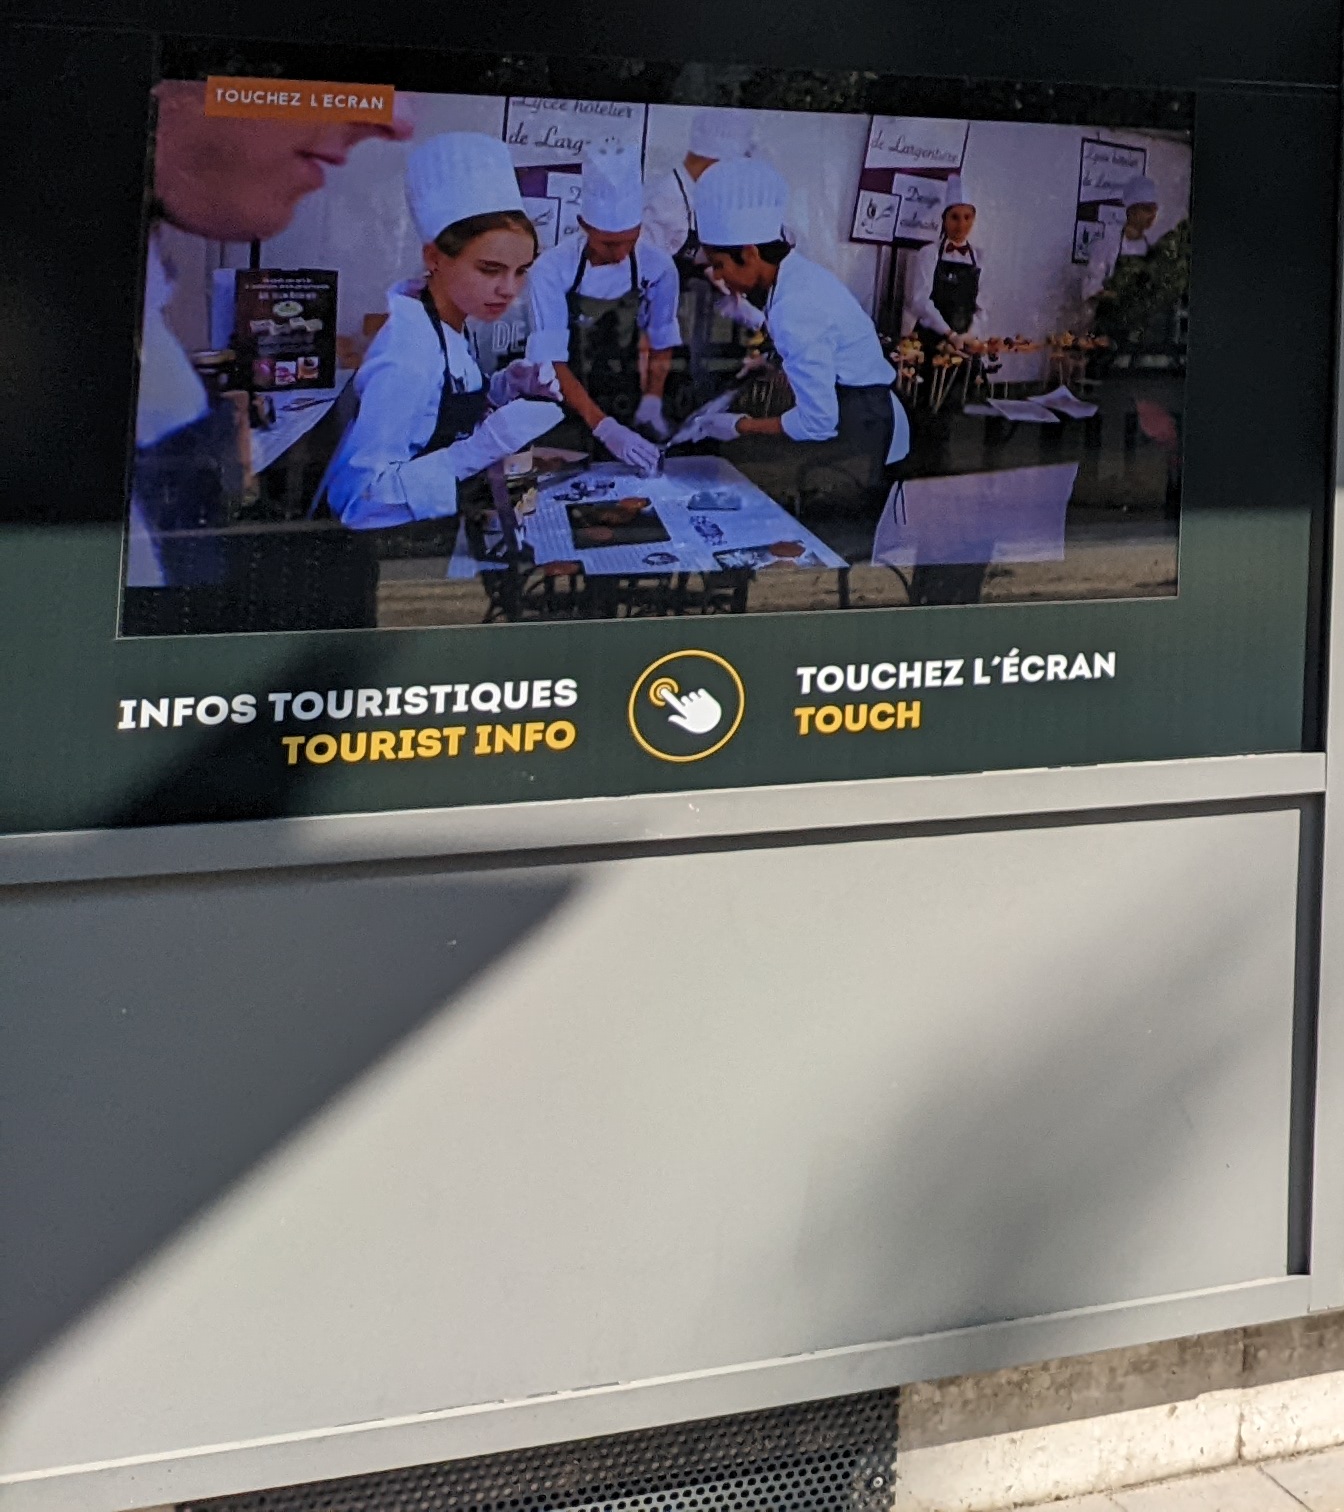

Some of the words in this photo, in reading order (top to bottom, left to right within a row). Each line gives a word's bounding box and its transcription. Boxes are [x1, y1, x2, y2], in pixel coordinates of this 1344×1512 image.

[215, 87, 302, 106] TOUCHEZ
[796, 658, 965, 695] TOUCHEZ
[117, 691, 257, 730] INFOS
[267, 678, 579, 723] TOURISTIQUES
[794, 700, 922, 736] TOUCH
[281, 726, 468, 765] TOURIST
[473, 720, 577, 756] INFO
